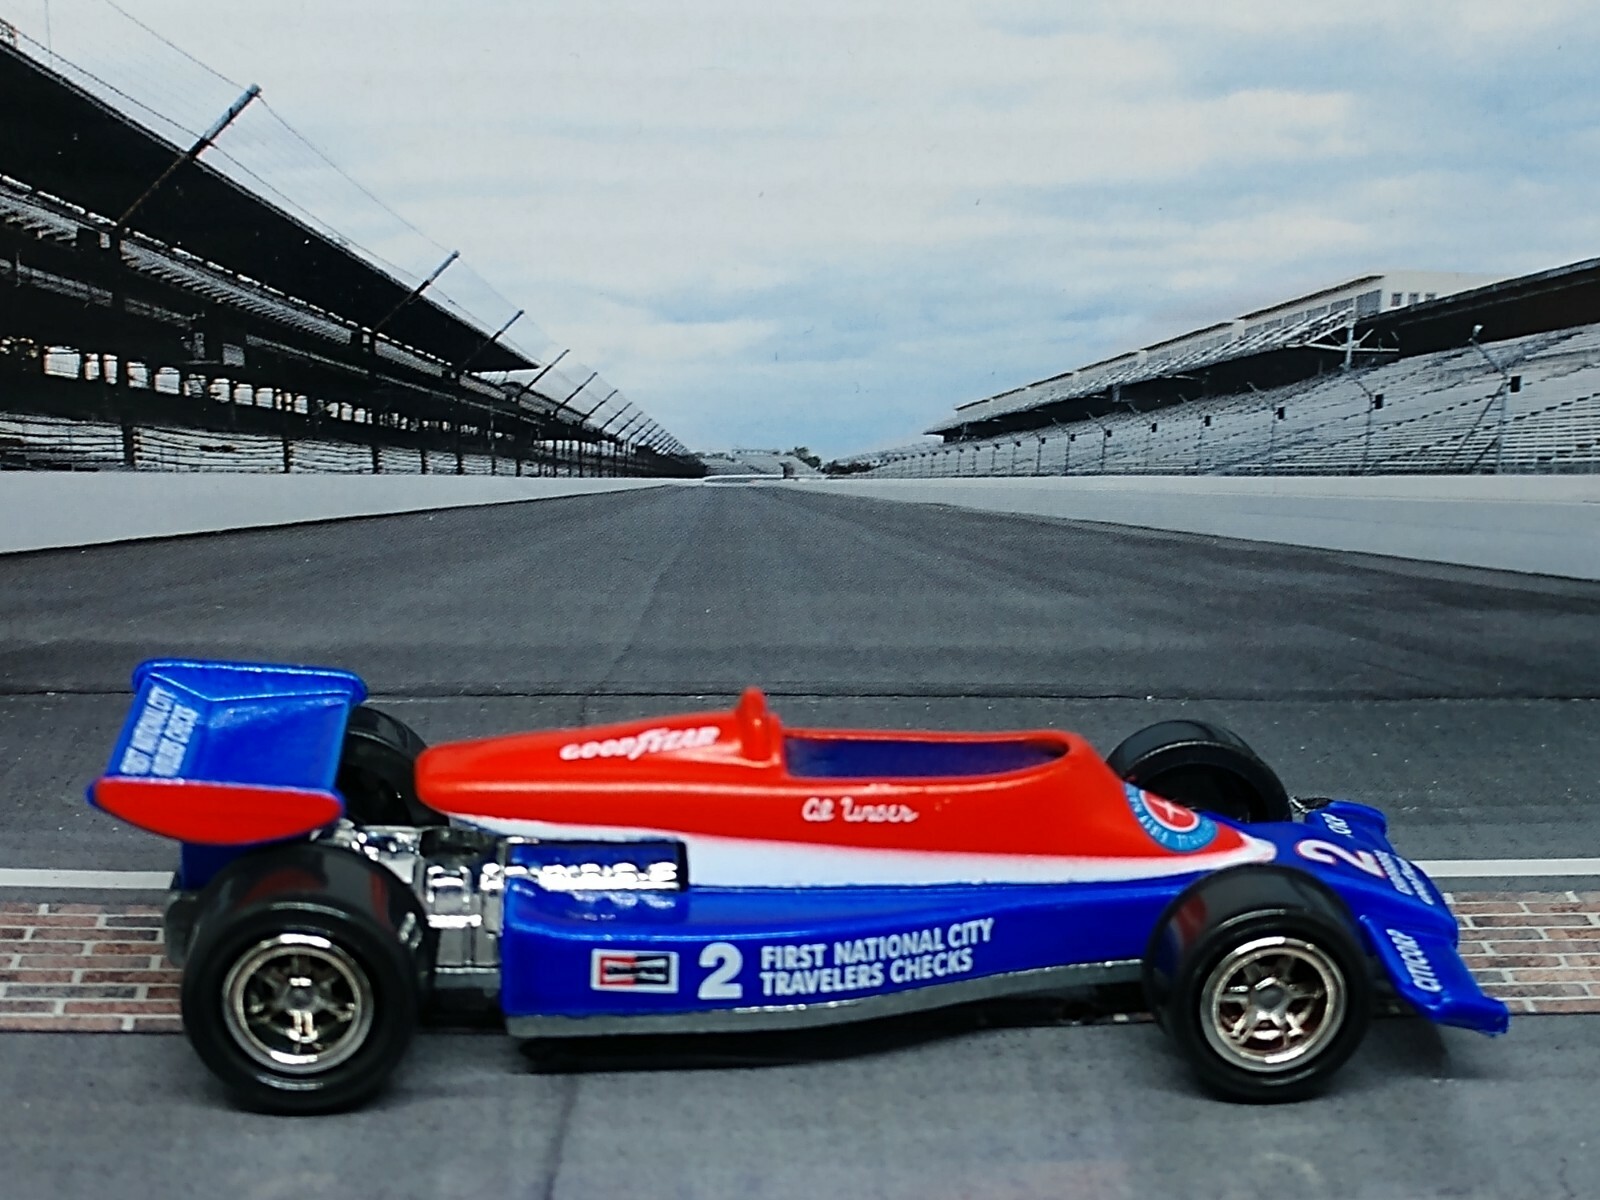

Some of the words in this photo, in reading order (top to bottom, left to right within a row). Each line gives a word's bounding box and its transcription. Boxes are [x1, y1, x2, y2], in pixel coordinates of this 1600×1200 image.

[760, 943, 828, 970] FIRST
[833, 926, 947, 966] NATIONAL
[947, 917, 995, 949] CITY
[697, 941, 743, 1000] 2
[759, 961, 885, 997] TRAVELERS
[889, 947, 974, 984] CHECKS
